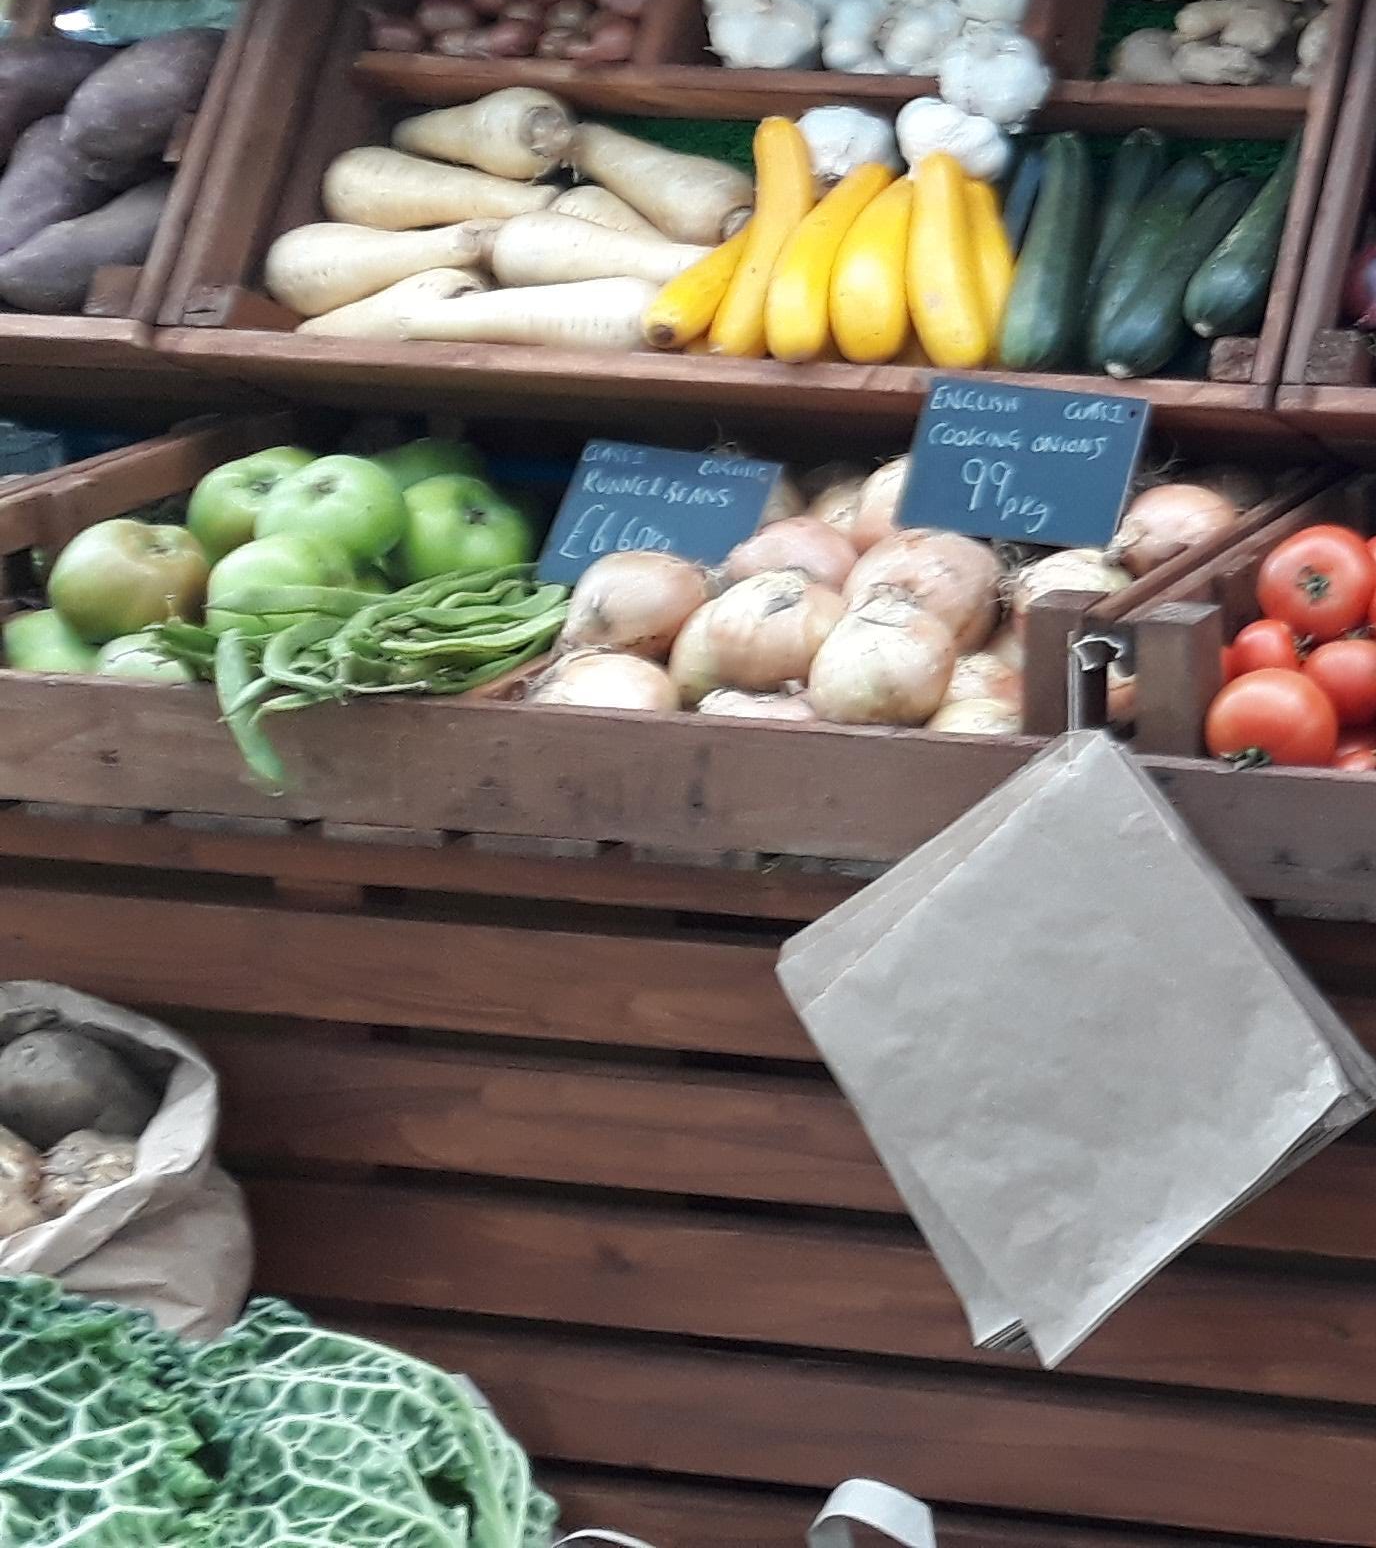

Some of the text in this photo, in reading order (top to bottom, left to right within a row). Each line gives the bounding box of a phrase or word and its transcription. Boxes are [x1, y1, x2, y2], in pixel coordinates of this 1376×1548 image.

[929, 385, 1021, 412] ENGLISH
[928, 422, 1110, 460] COOKING ONIONS
[582, 470, 730, 508] RUNNER BEANS
